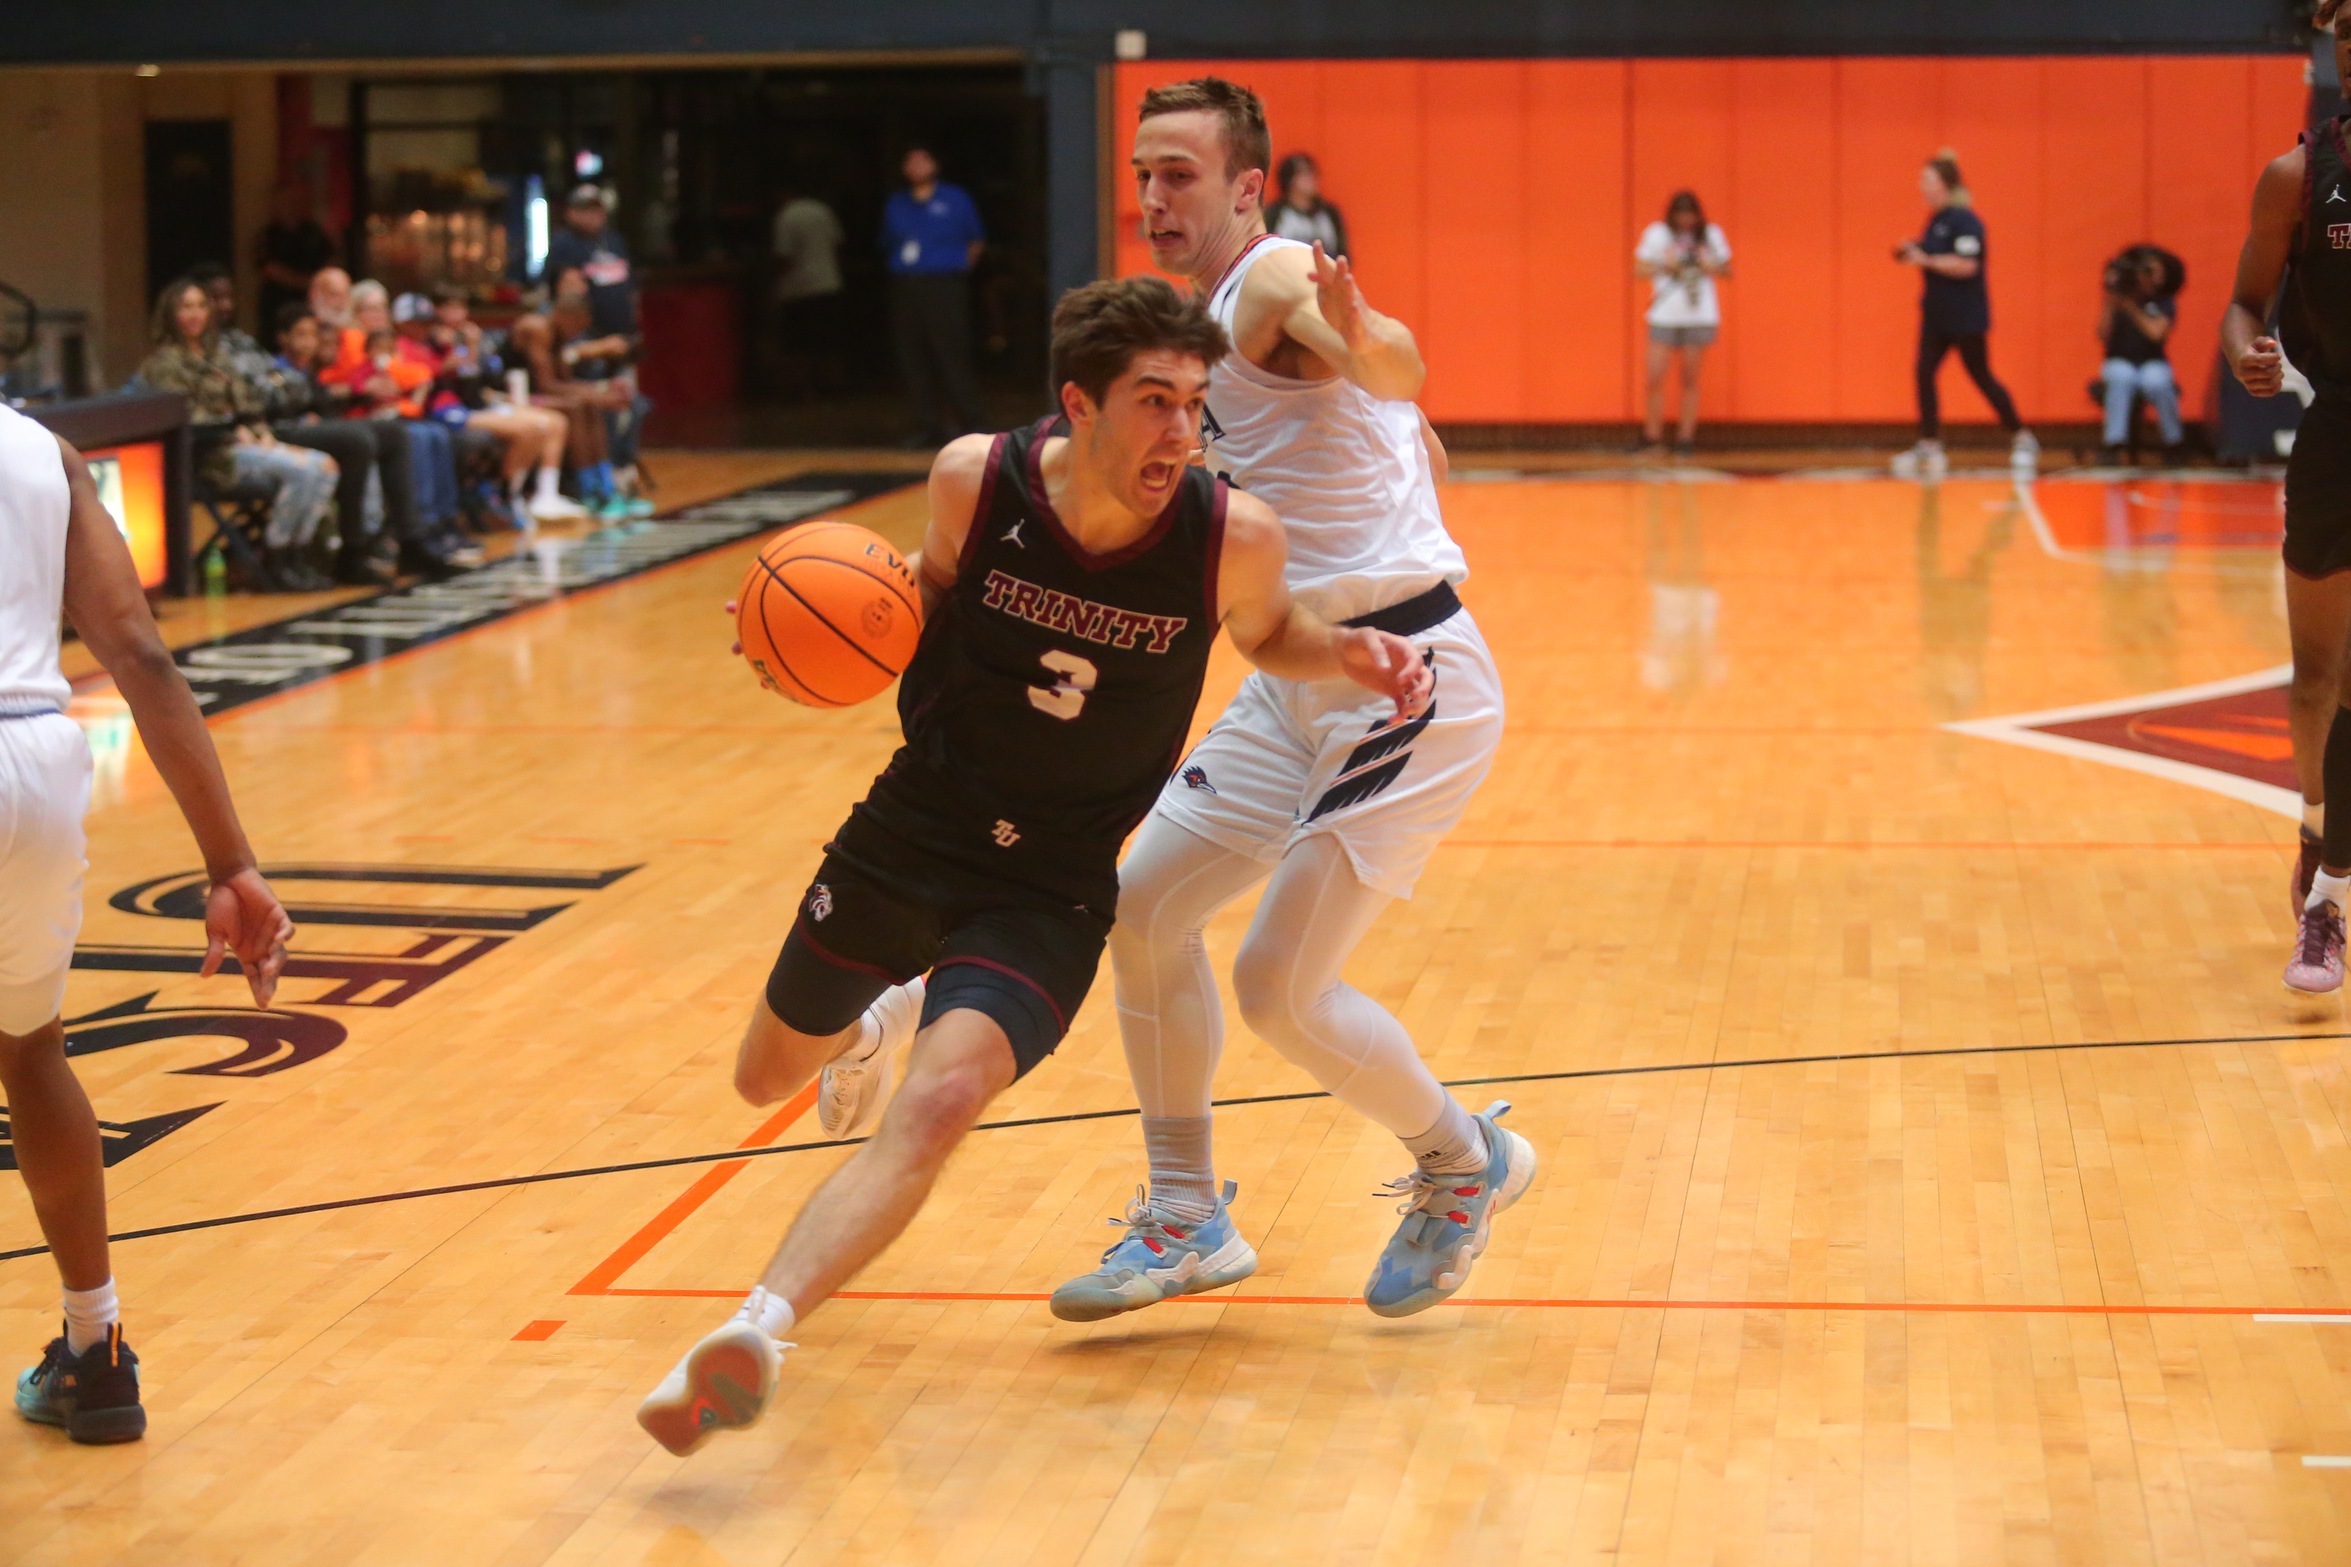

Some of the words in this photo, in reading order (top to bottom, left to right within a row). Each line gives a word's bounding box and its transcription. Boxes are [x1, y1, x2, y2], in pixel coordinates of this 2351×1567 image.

[983, 569, 1188, 654] TRINITY
[1027, 649, 1098, 721] 3
[991, 818, 1021, 848] TU
